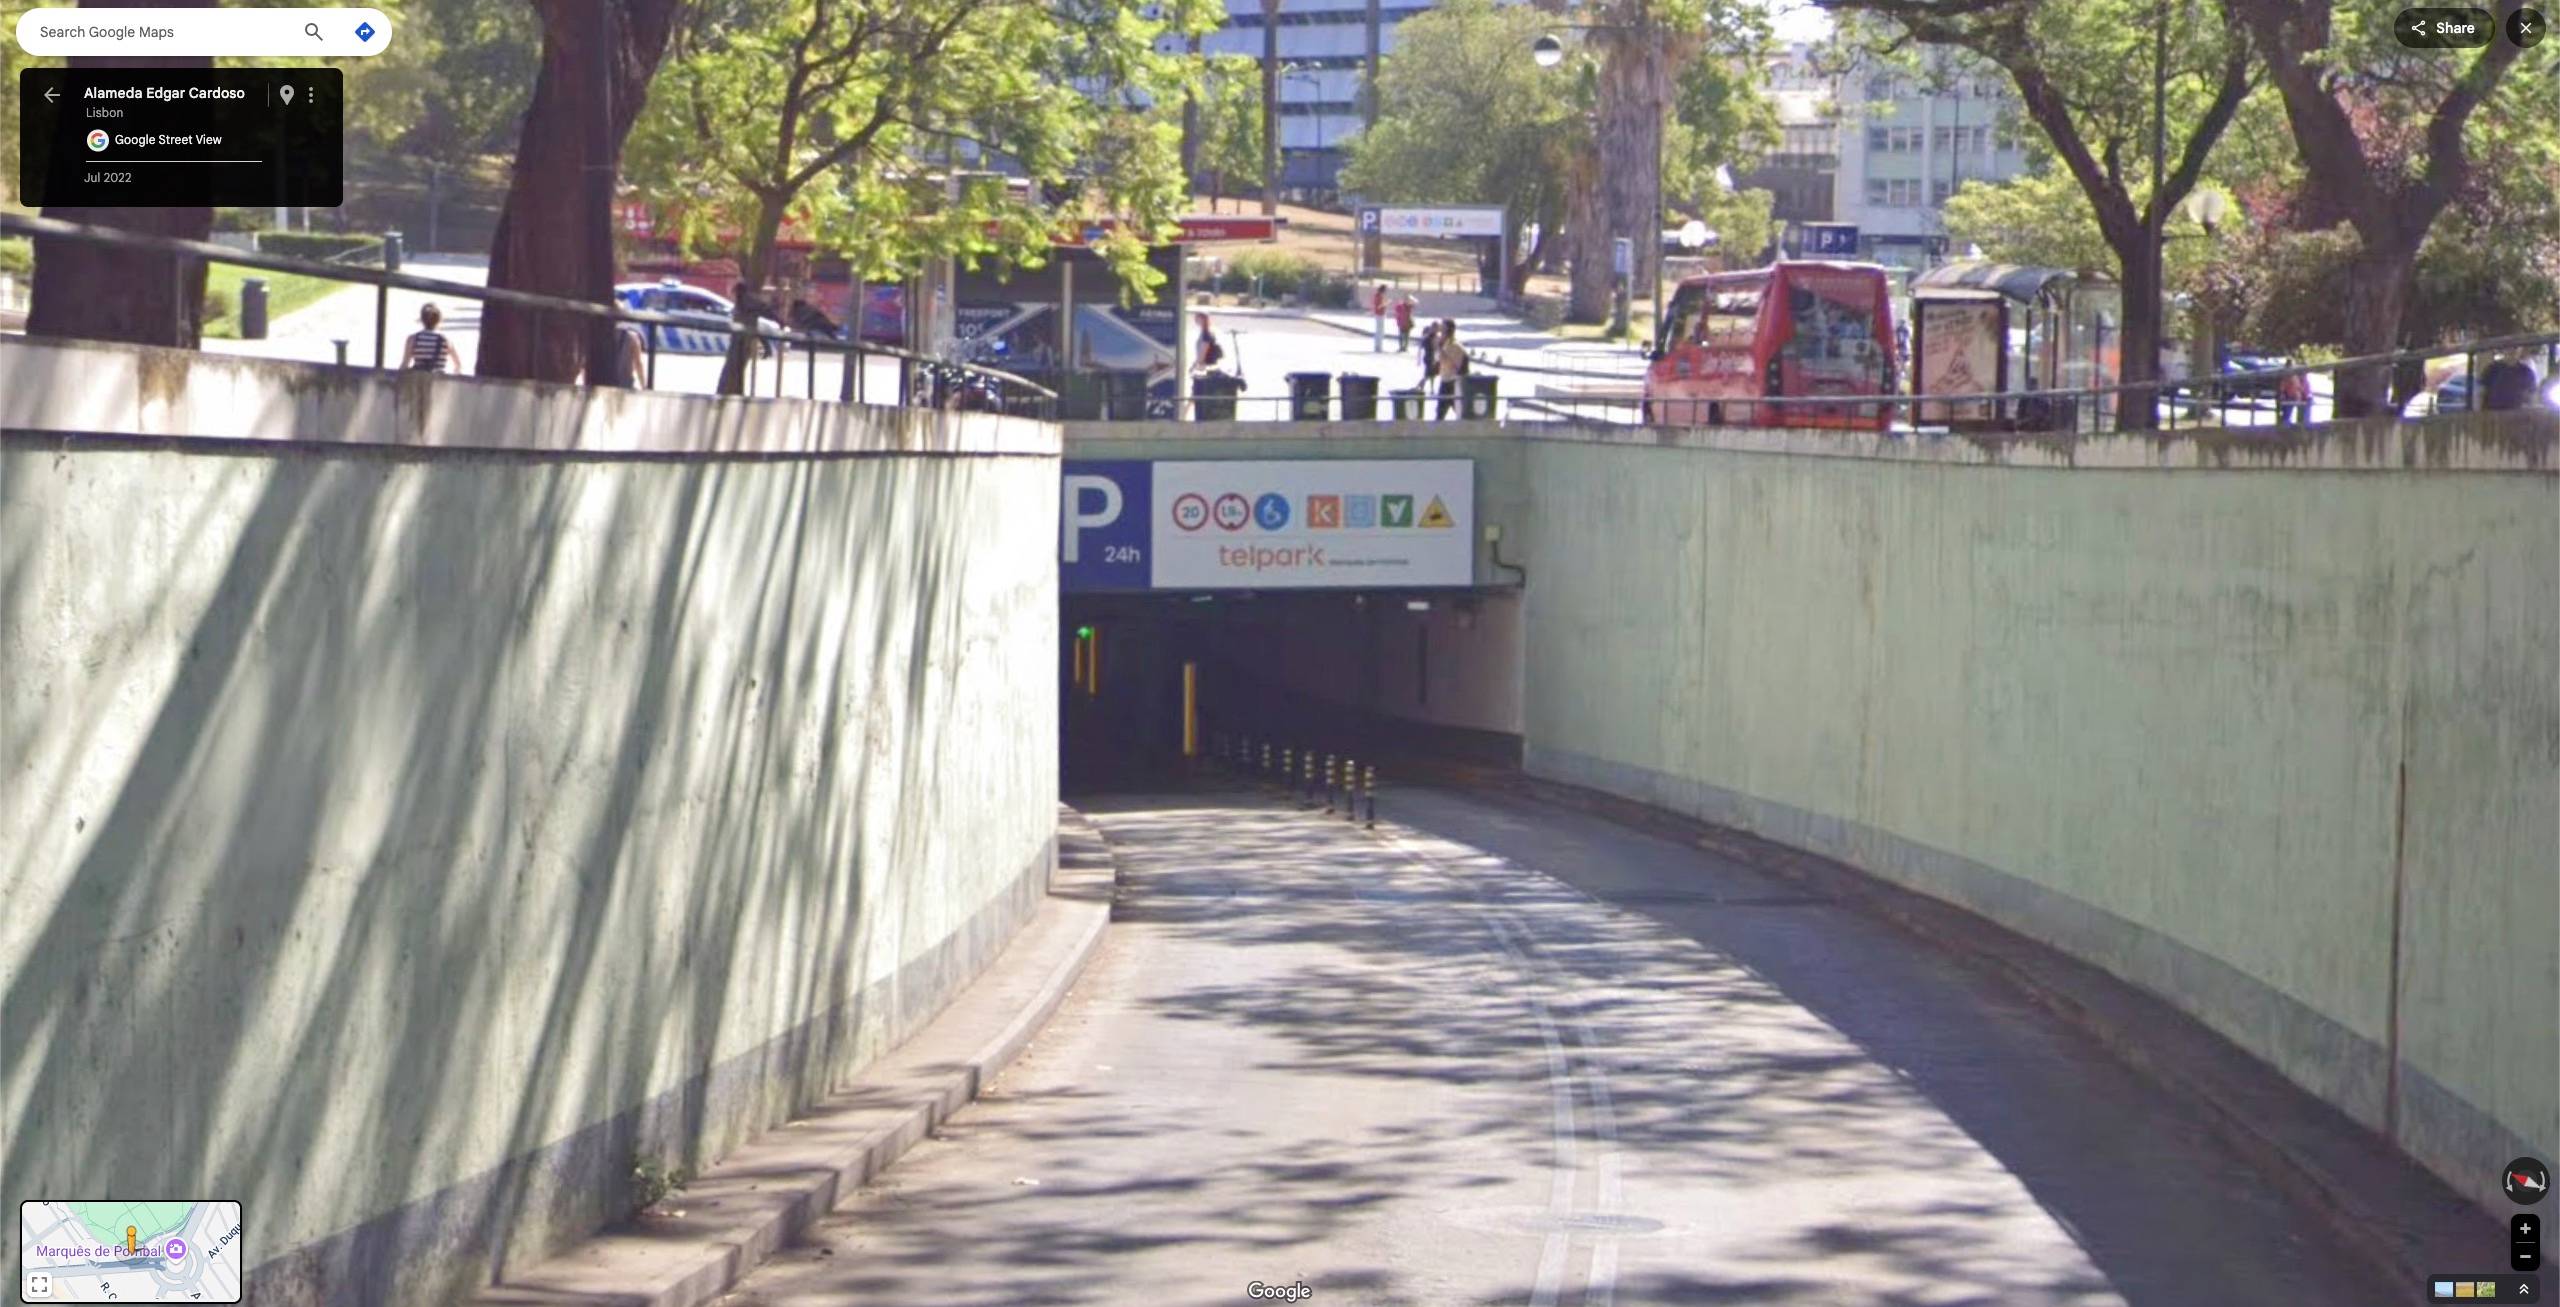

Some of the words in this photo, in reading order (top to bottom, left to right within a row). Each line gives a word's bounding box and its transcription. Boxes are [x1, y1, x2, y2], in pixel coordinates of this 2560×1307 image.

[1362, 211, 1377, 231] P
[1063, 474, 1123, 563] P
[1182, 505, 1200, 519] 20
[1104, 544, 1141, 563] 24h
[1218, 543, 1326, 572] telpark
